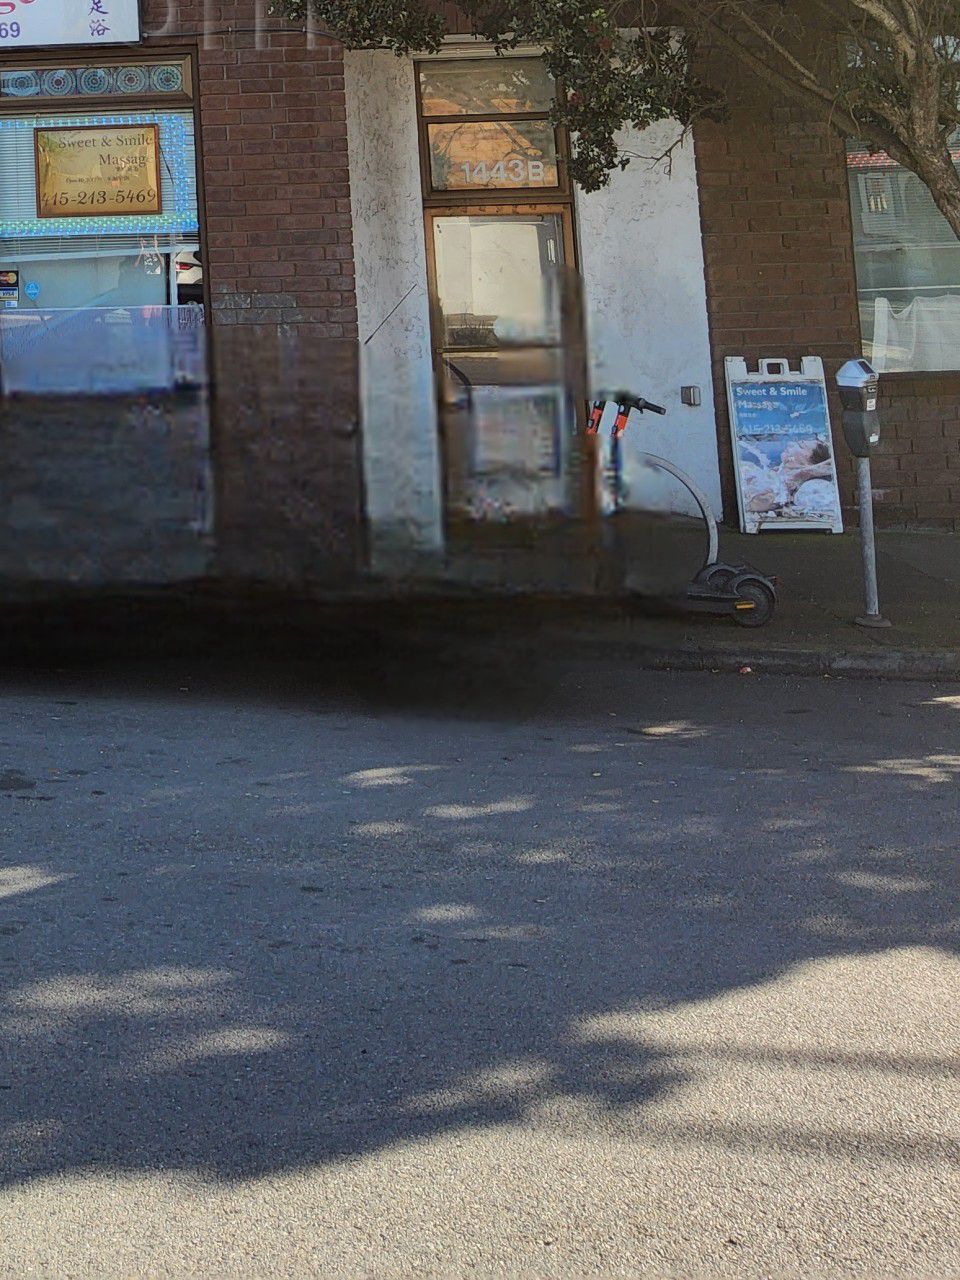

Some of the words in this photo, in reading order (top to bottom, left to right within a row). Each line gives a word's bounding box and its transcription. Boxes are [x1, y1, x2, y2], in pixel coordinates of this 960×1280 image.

[58, 136, 97, 149] Sweet
[101, 136, 112, 146] &
[116, 133, 153, 146] Smile
[461, 159, 544, 184] 1443B
[41, 189, 156, 207] 415-213-5469
[736, 387, 767, 396] Sweet
[769, 387, 778, 396] &
[780, 386, 808, 396] Smile
